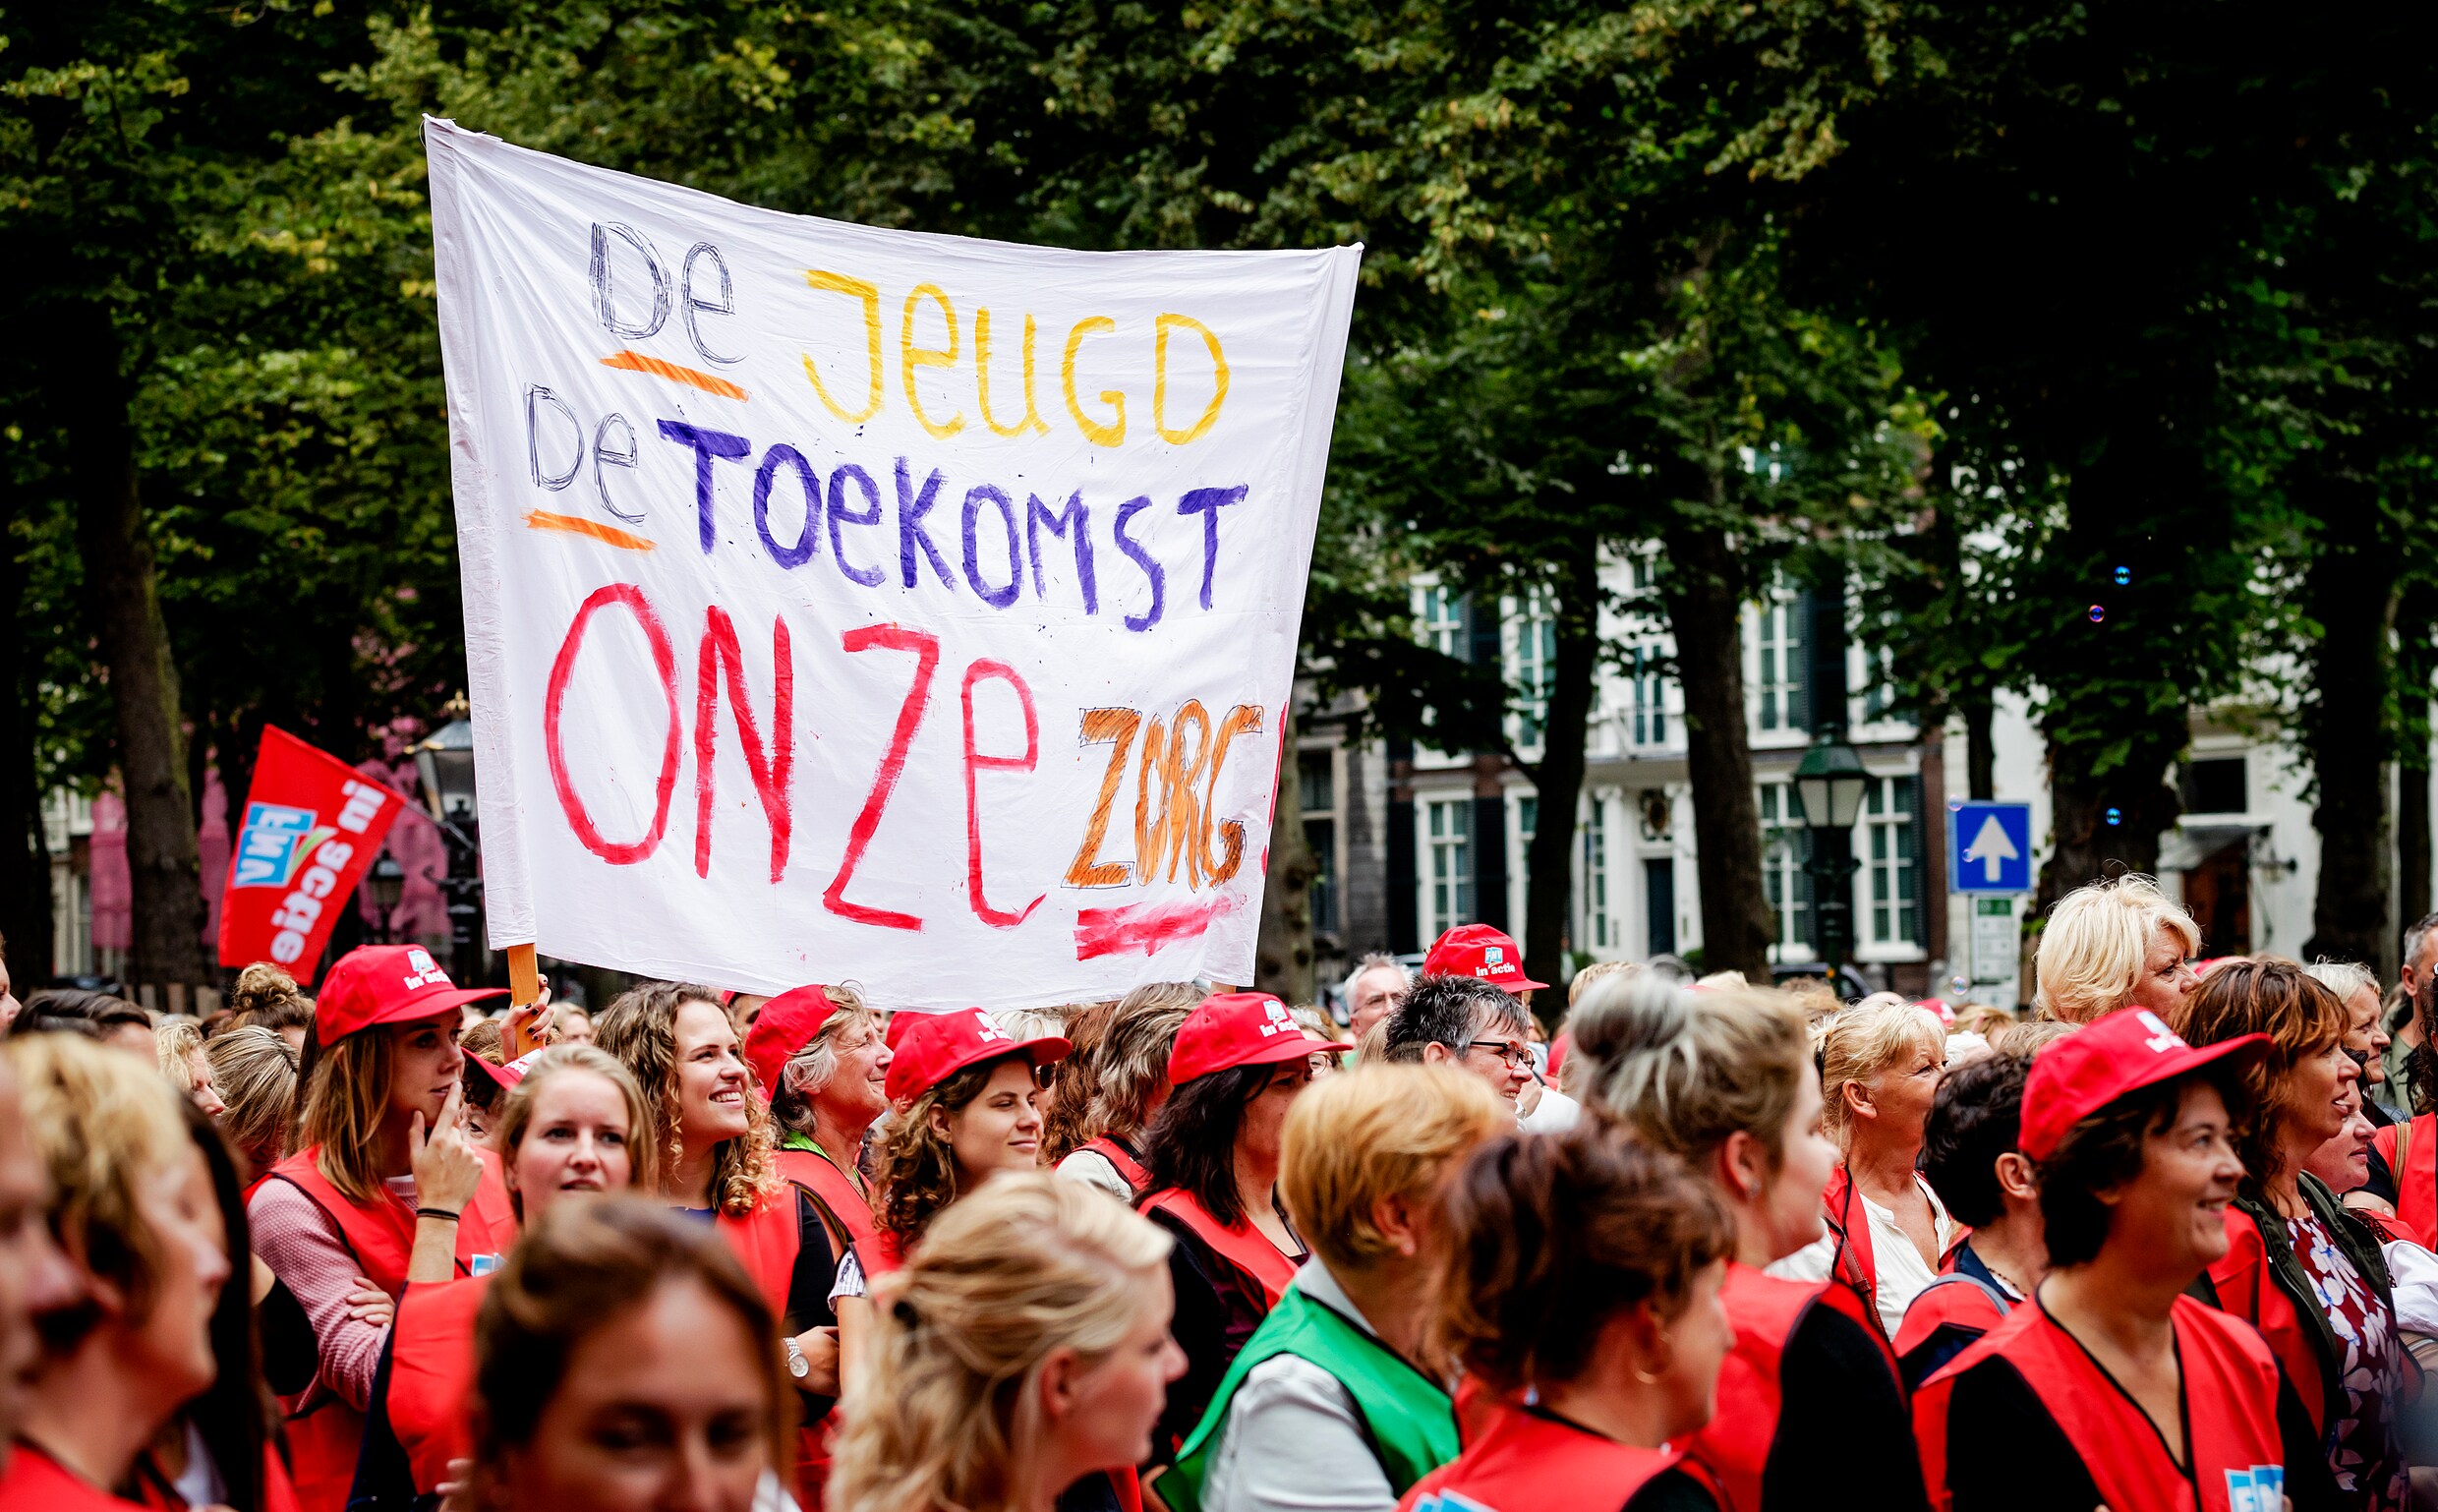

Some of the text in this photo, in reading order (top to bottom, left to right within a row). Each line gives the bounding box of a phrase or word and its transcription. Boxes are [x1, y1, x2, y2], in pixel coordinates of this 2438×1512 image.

[589, 221, 747, 371] De
[523, 382, 646, 527] De
[1476, 962, 1516, 976] in actie
